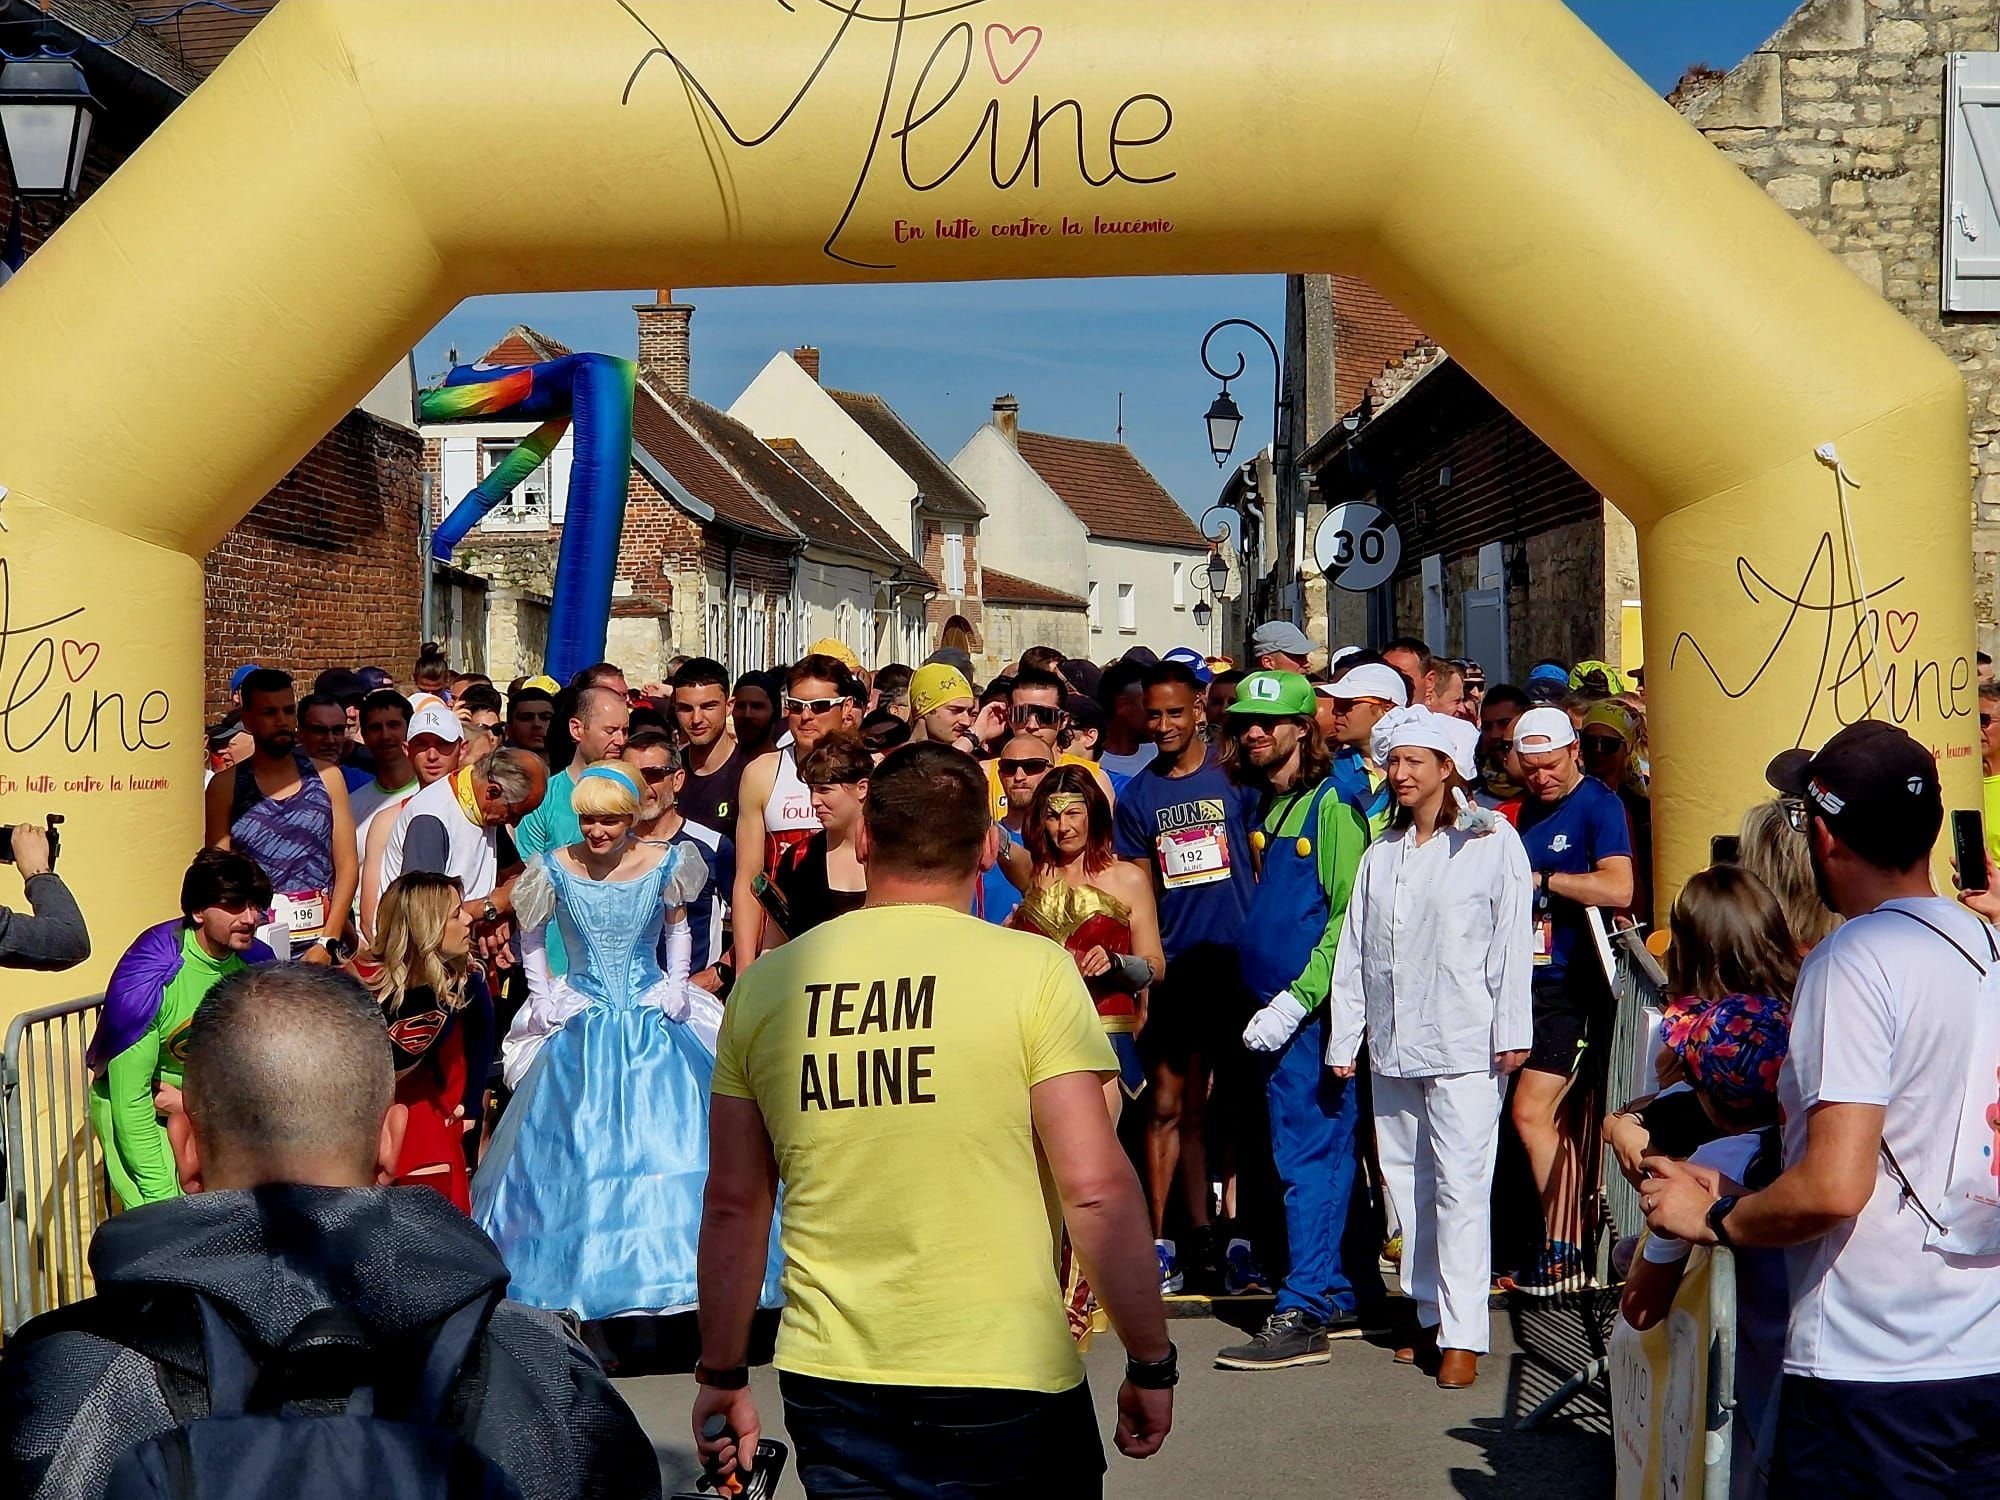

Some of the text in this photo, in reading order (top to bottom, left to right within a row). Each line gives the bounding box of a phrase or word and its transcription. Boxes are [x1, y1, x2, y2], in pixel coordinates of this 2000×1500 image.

[894, 215, 1175, 244] En lutte contre la leucémie
[1333, 529, 1385, 566] 30
[0, 556, 171, 754] line
[1257, 679, 1273, 698] L
[26, 775, 57, 794] lutte
[64, 774, 104, 793] contre
[110, 775, 123, 793] la
[1156, 801, 1200, 831] RUN
[1180, 850, 1203, 864] 192
[293, 908, 313, 921] 196
[804, 975, 937, 1039] TEAM
[800, 1045, 937, 1112] ALINE
